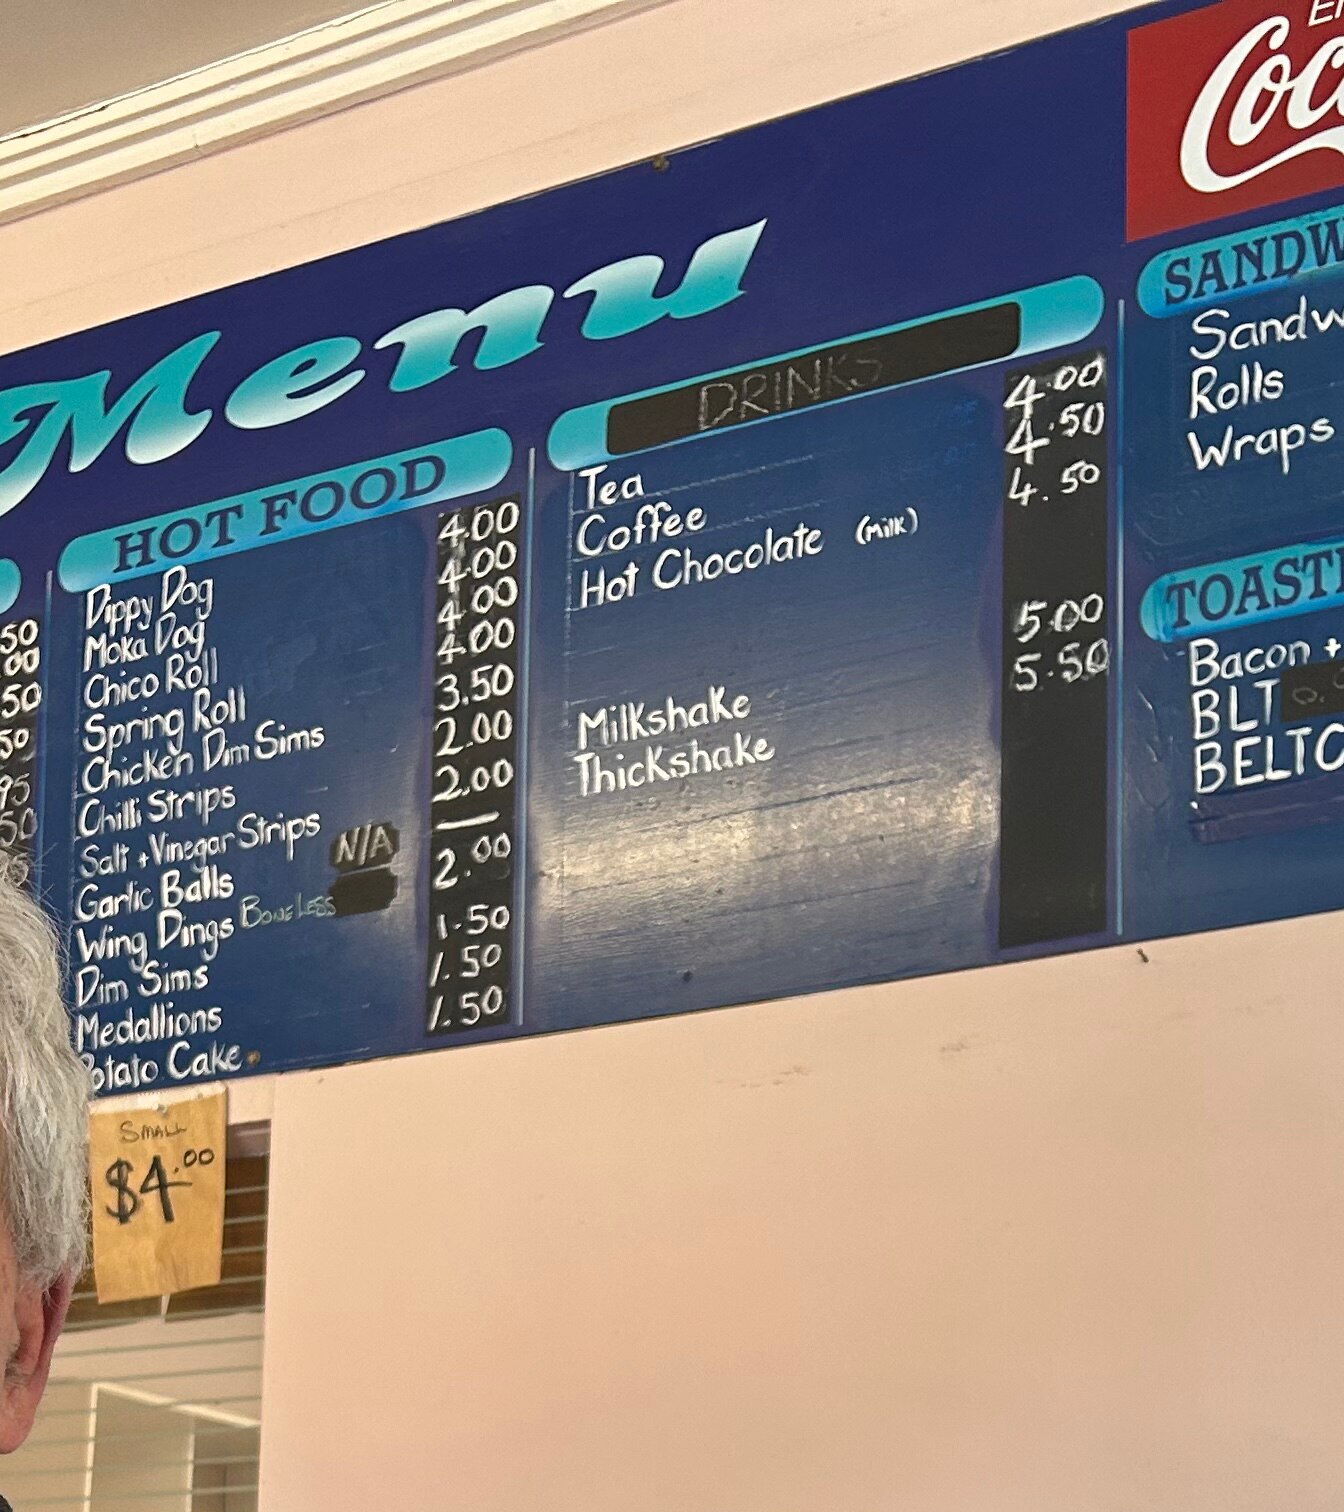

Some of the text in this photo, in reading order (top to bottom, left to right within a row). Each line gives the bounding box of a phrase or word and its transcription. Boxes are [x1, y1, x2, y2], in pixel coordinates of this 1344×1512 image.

[698, 353, 883, 430] DRINKS
[1003, 357, 1104, 419] 4.00
[1188, 361, 1285, 419] Rolls
[1005, 402, 1105, 465] 4.50
[1186, 415, 1336, 474] Wraps
[579, 465, 645, 509] Tea
[1009, 460, 1100, 506] 4.50
[113, 455, 447, 573] HOT FOOD
[438, 501, 519, 548] 4.00
[577, 501, 706, 556] Coffee
[437, 540, 517, 593] 4.00
[580, 561, 639, 609] Hot
[652, 522, 824, 590] Chocolate
[85, 564, 214, 637] Dippy Dog
[1014, 593, 1104, 643] 5.00
[83, 612, 206, 673] Moka Dog
[437, 617, 515, 665] 4.00
[1014, 638, 1110, 691] 5.50
[1188, 637, 1310, 687] Bacon
[83, 647, 218, 710] Chico Roll
[436, 663, 514, 711] 3.50
[82, 684, 246, 767] Spring Roll
[434, 709, 513, 757] 2.00
[577, 686, 752, 752] Milkshake
[1192, 678, 1280, 740] BLT
[81, 719, 325, 794] Chicken Dim Sims
[432, 759, 513, 802] 2.00
[574, 732, 775, 798] Thickshake
[78, 783, 236, 838] Chilli Strips
[79, 843, 130, 879] Salt
[236, 811, 321, 862] Strips
[336, 823, 394, 866] N/A
[433, 832, 511, 890] 2.00
[75, 865, 234, 923] Garlic Balls
[438, 905, 510, 940] 1.50
[77, 924, 148, 975] Wing
[157, 908, 236, 962] Dings
[75, 959, 209, 1009] Dim Sims
[76, 1001, 223, 1052] Medallions
[167, 1041, 243, 1079] Cake
